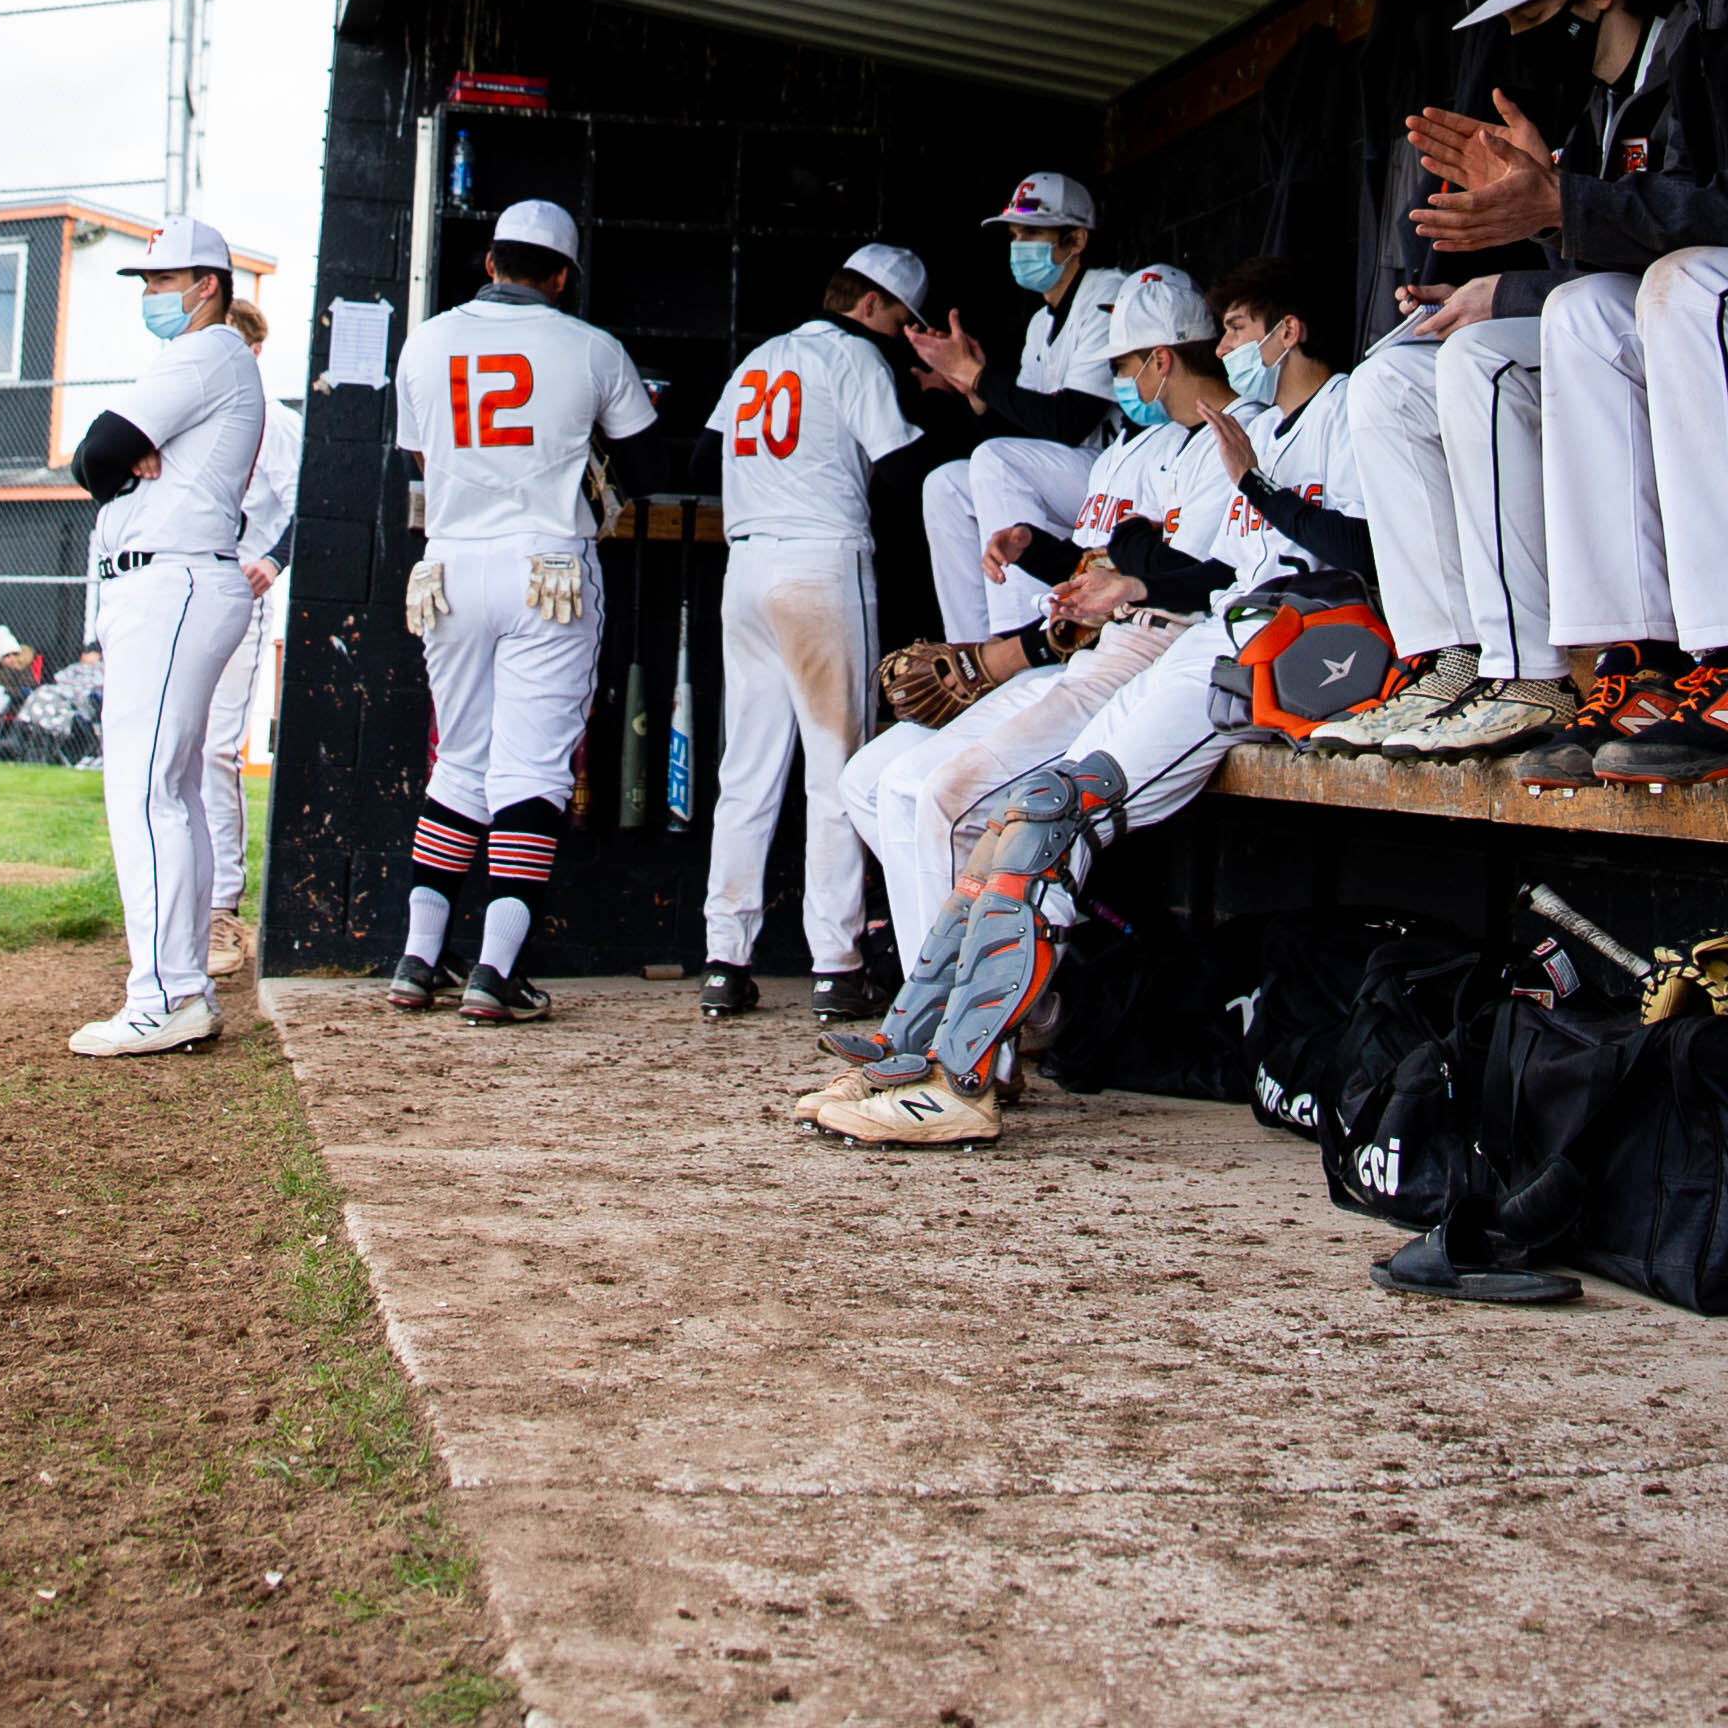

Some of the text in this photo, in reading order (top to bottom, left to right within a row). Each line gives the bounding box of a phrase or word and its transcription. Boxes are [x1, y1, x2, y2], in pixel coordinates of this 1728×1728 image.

[449, 353, 534, 449] 12
[734, 369, 802, 460] 20
[128, 1012, 161, 1037] N
[897, 1090, 945, 1122] N
